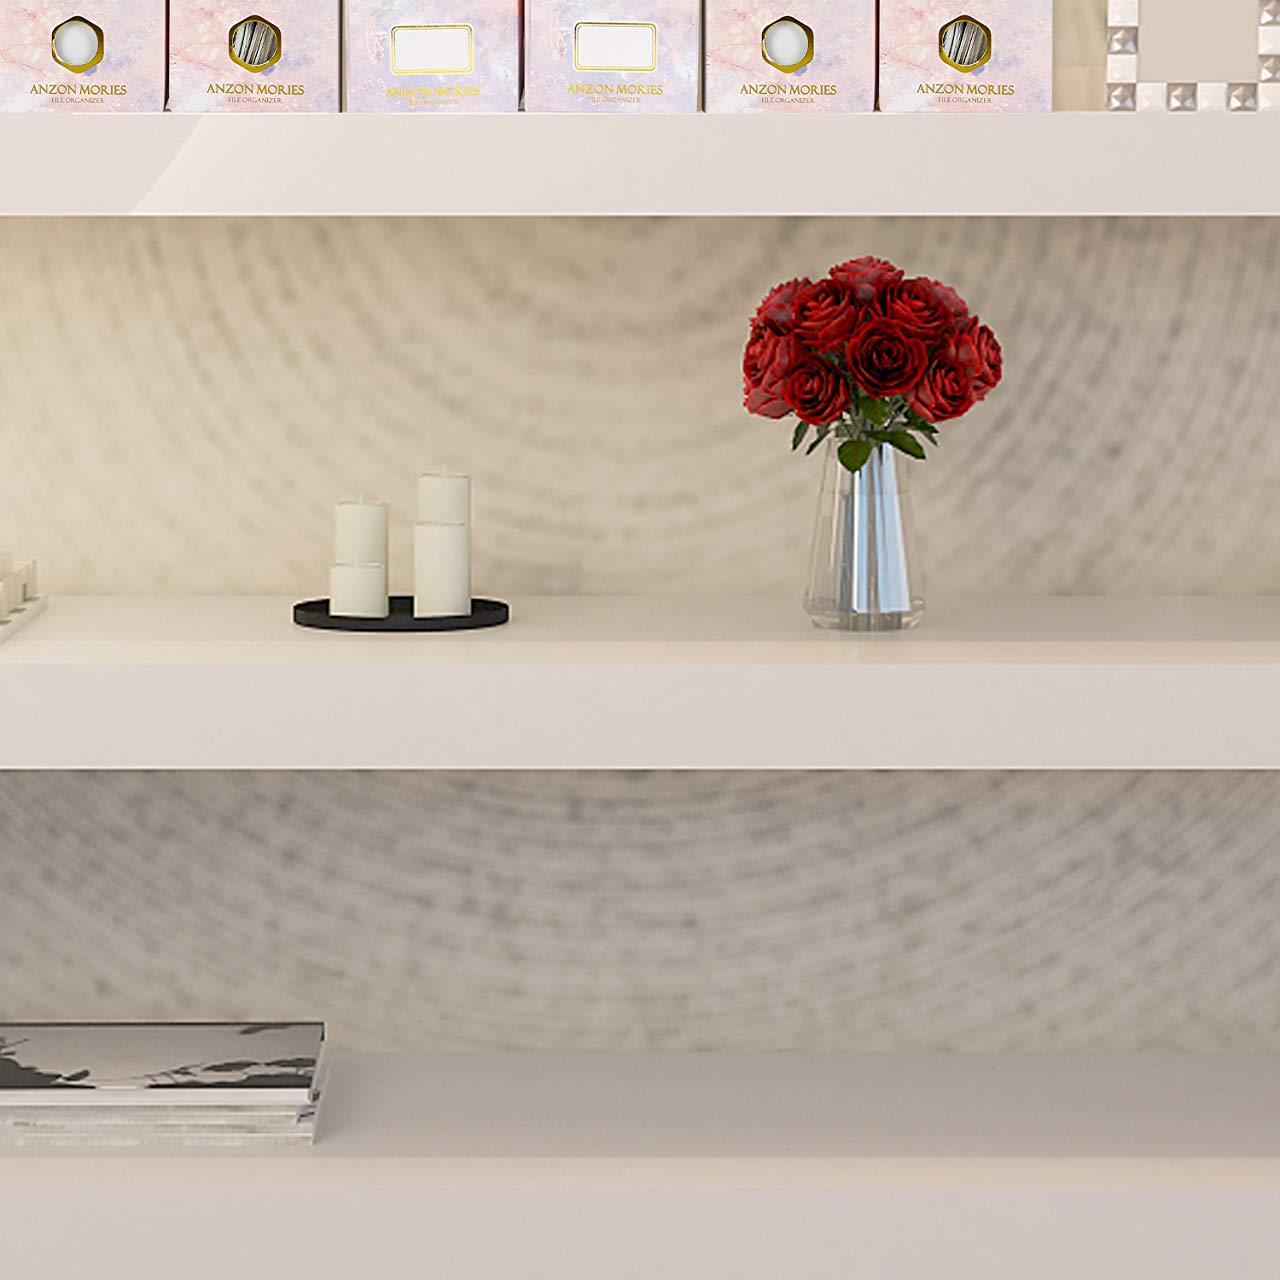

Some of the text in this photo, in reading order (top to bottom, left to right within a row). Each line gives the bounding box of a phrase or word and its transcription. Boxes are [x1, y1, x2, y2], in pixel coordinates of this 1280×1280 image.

[30, 84, 127, 95] ANZON MORIES
[206, 84, 305, 95] ANZON MORIES
[567, 84, 664, 95] ANZON MORIES
[740, 84, 838, 95] ANZON MORIES
[917, 84, 1015, 95] ANZON MORIES
